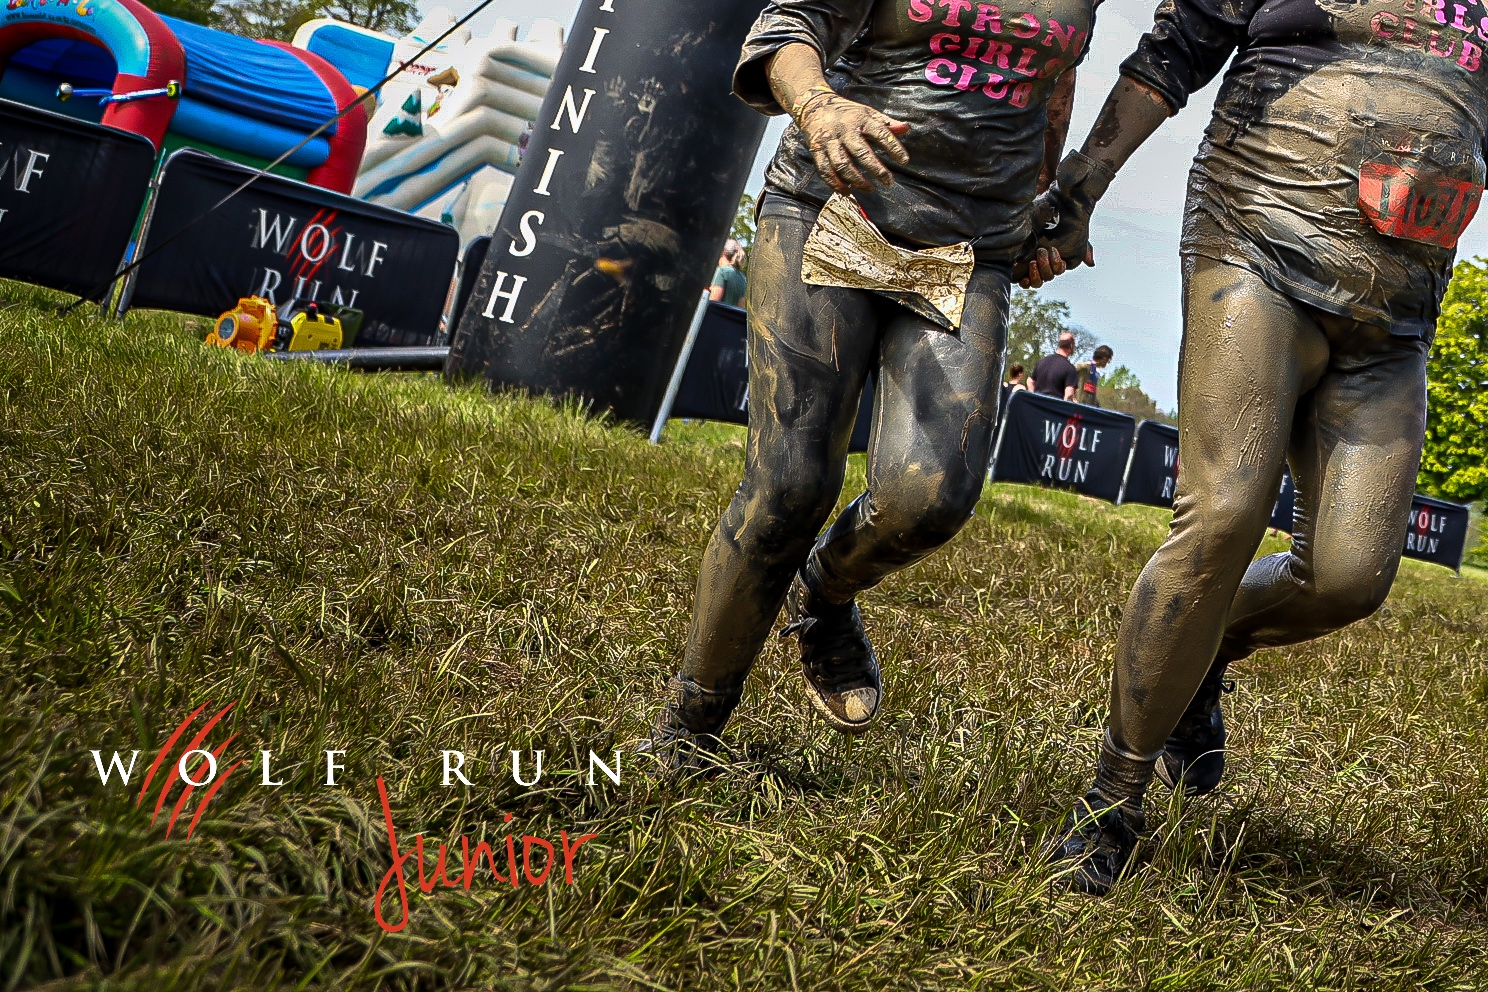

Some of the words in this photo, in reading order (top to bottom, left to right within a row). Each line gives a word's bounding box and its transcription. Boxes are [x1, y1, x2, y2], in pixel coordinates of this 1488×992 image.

[1370, 11, 1483, 72] CLUB
[924, 58, 1034, 108] CLUB
[259, 208, 388, 278] WOLF
[1044, 420, 1102, 453] WOLF
[1041, 454, 1090, 483] RUN
[1406, 532, 1440, 554] RUN
